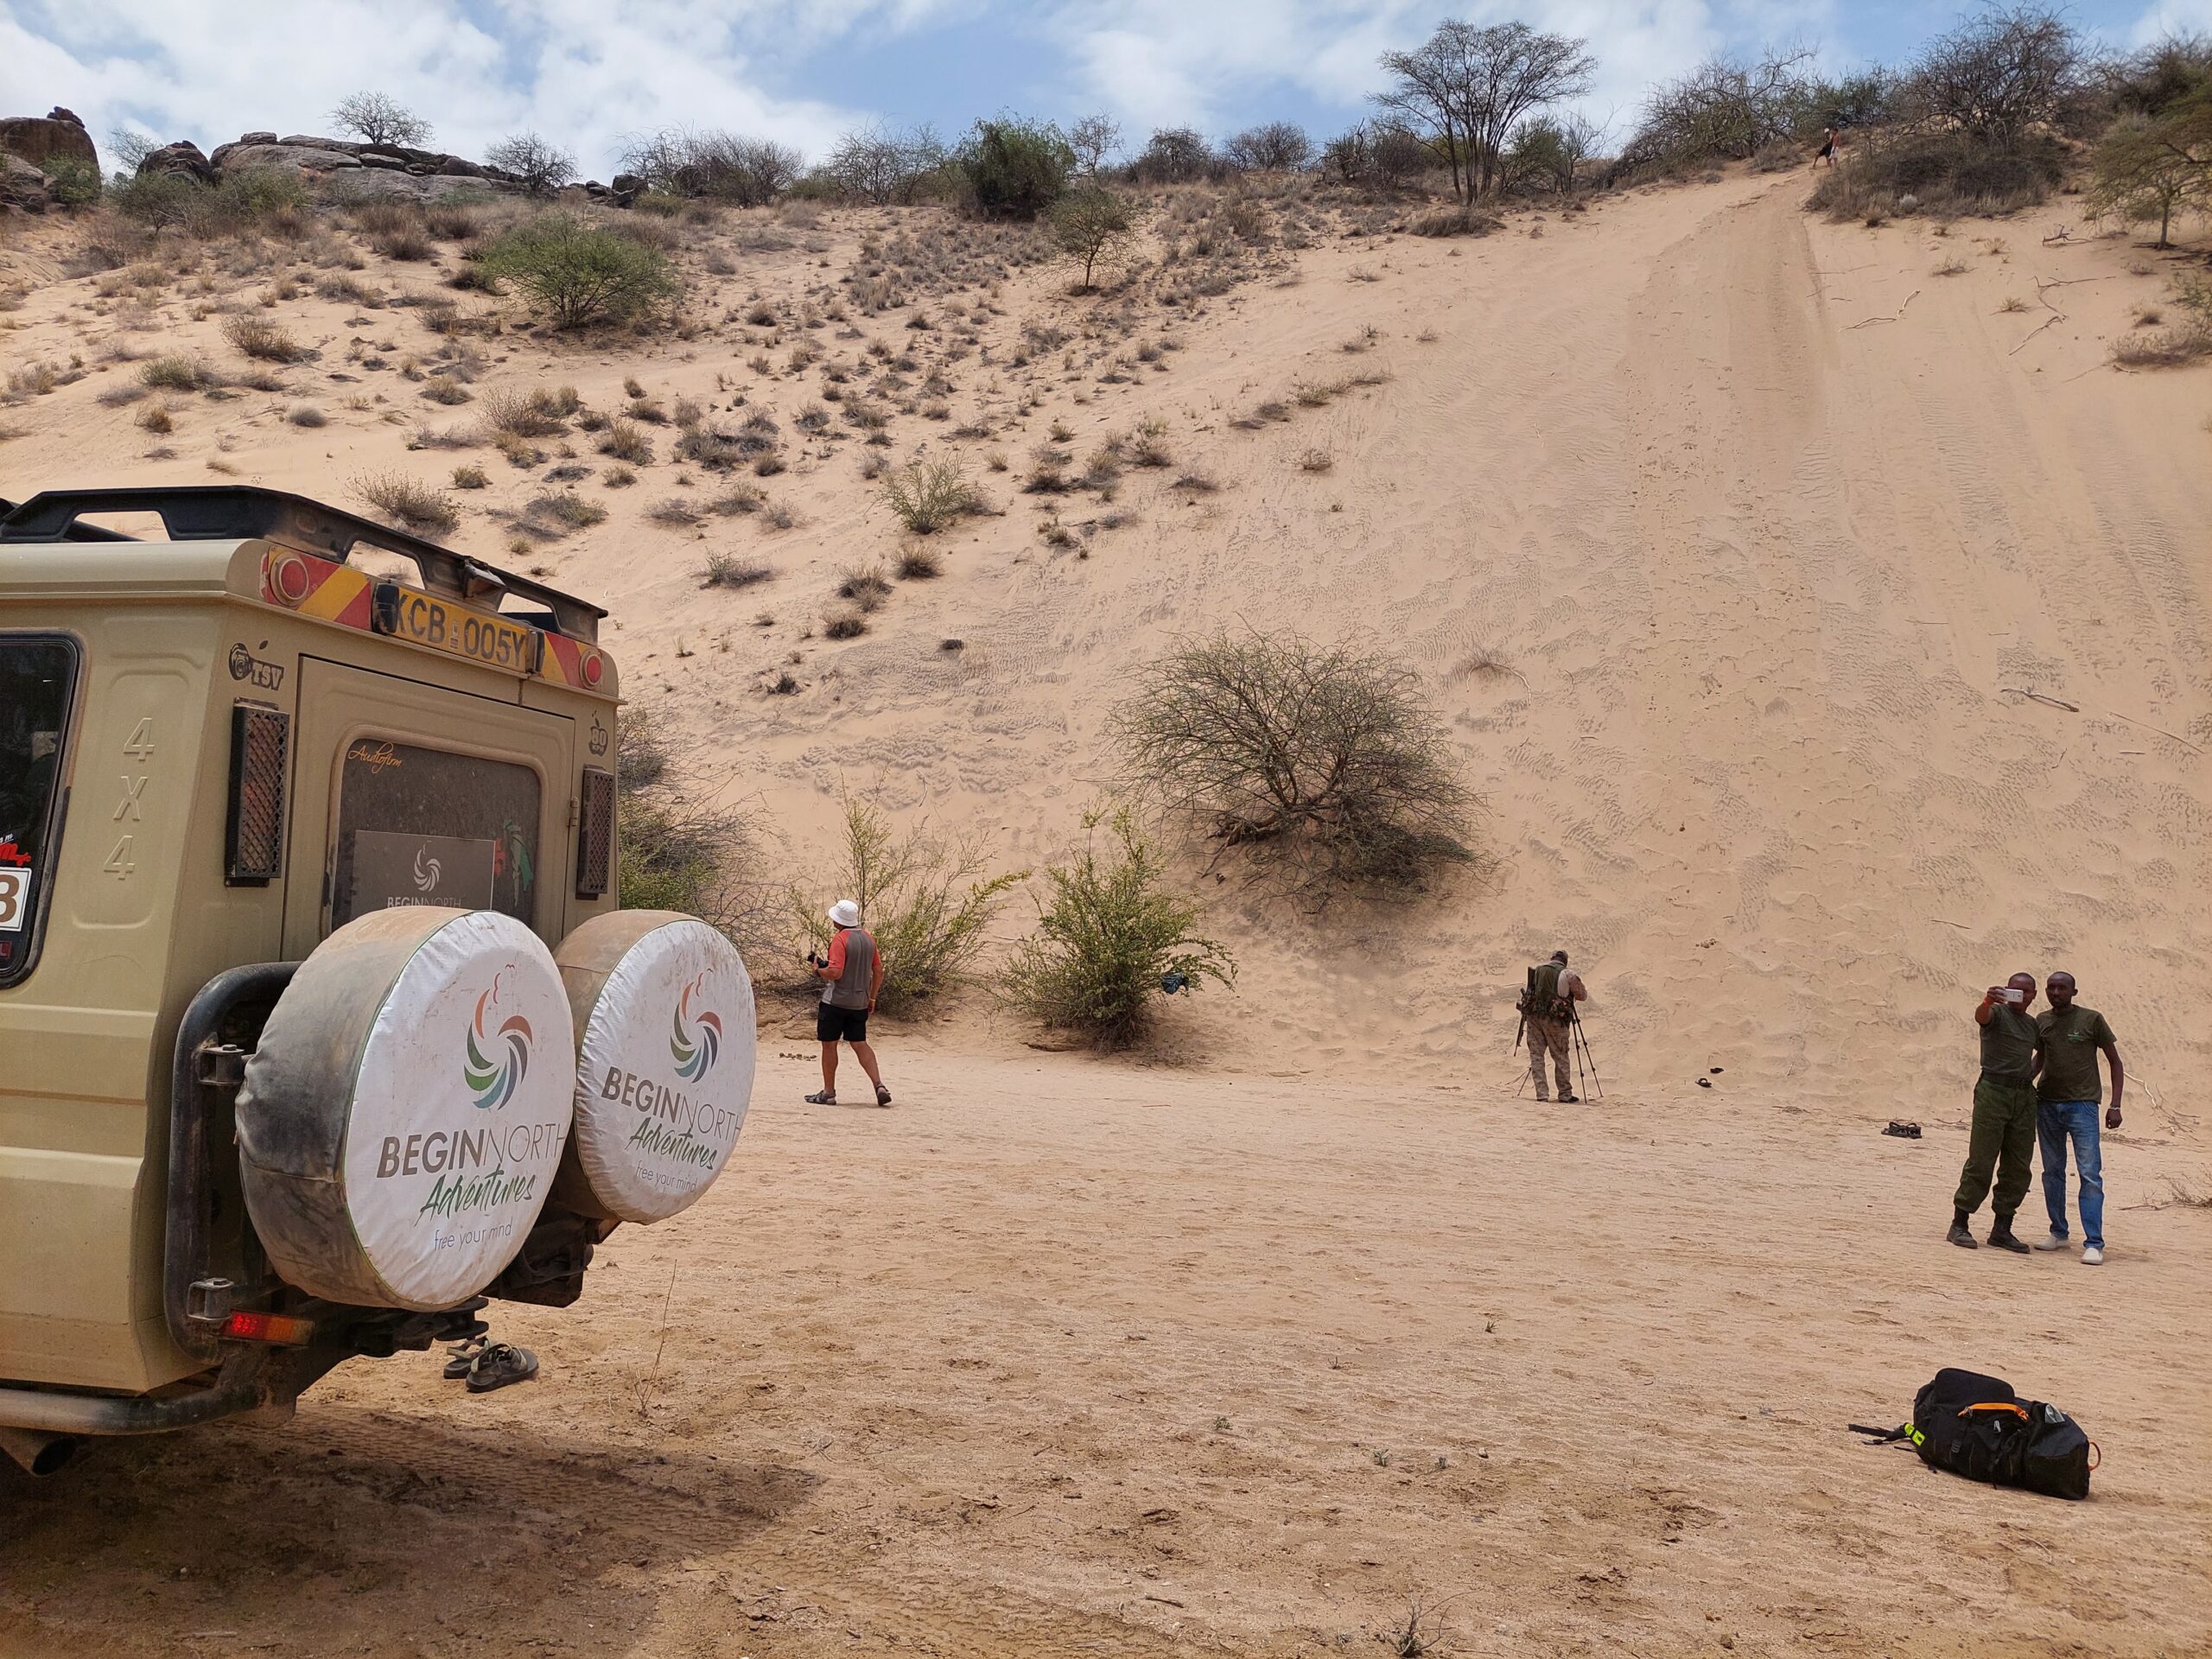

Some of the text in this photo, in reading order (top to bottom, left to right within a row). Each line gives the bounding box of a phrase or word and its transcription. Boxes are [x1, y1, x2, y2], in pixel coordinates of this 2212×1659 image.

[397, 594, 525, 665] KCB 005Y
[251, 662, 283, 690] TSV
[592, 728, 607, 747] 80
[625, 1116, 718, 1171] Adventures
[635, 1160, 698, 1193] free your mind
[414, 1163, 537, 1228] Adventures
[434, 1216, 513, 1252] free your mind
